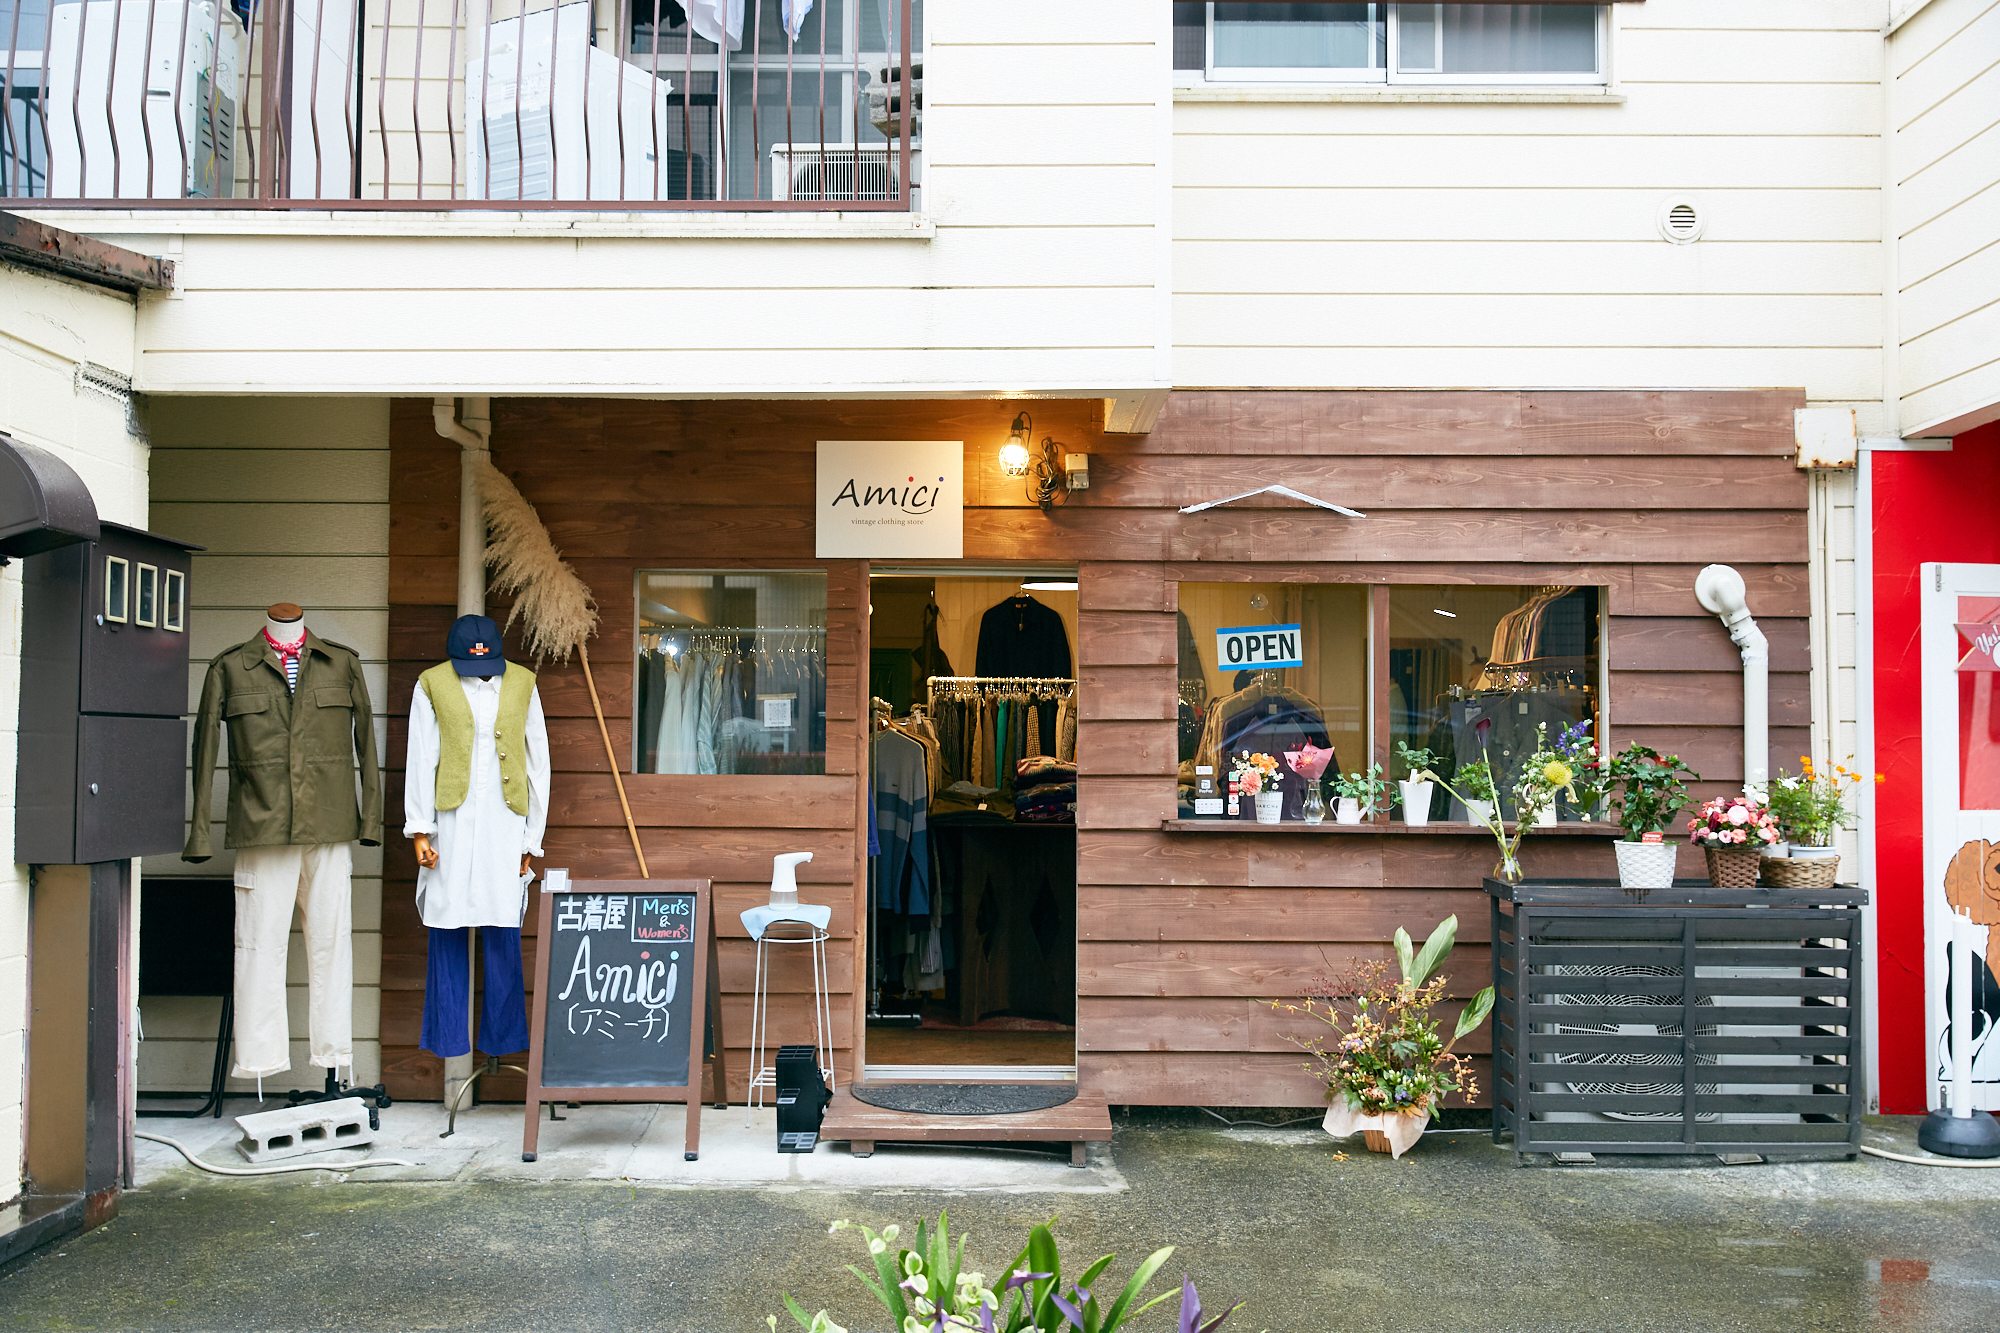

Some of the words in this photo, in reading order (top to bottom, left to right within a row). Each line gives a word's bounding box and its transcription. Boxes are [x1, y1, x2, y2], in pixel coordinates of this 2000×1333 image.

[832, 476, 944, 508] Amici
[851, 518, 876, 526] vintage
[877, 518, 906, 526] clothing
[1226, 633, 1295, 663] OPEN
[557, 895, 629, 932] 古着屋
[643, 899, 690, 916] Men's
[638, 924, 689, 940] Women's
[660, 915, 671, 928] &
[558, 934, 680, 1005] Amici
